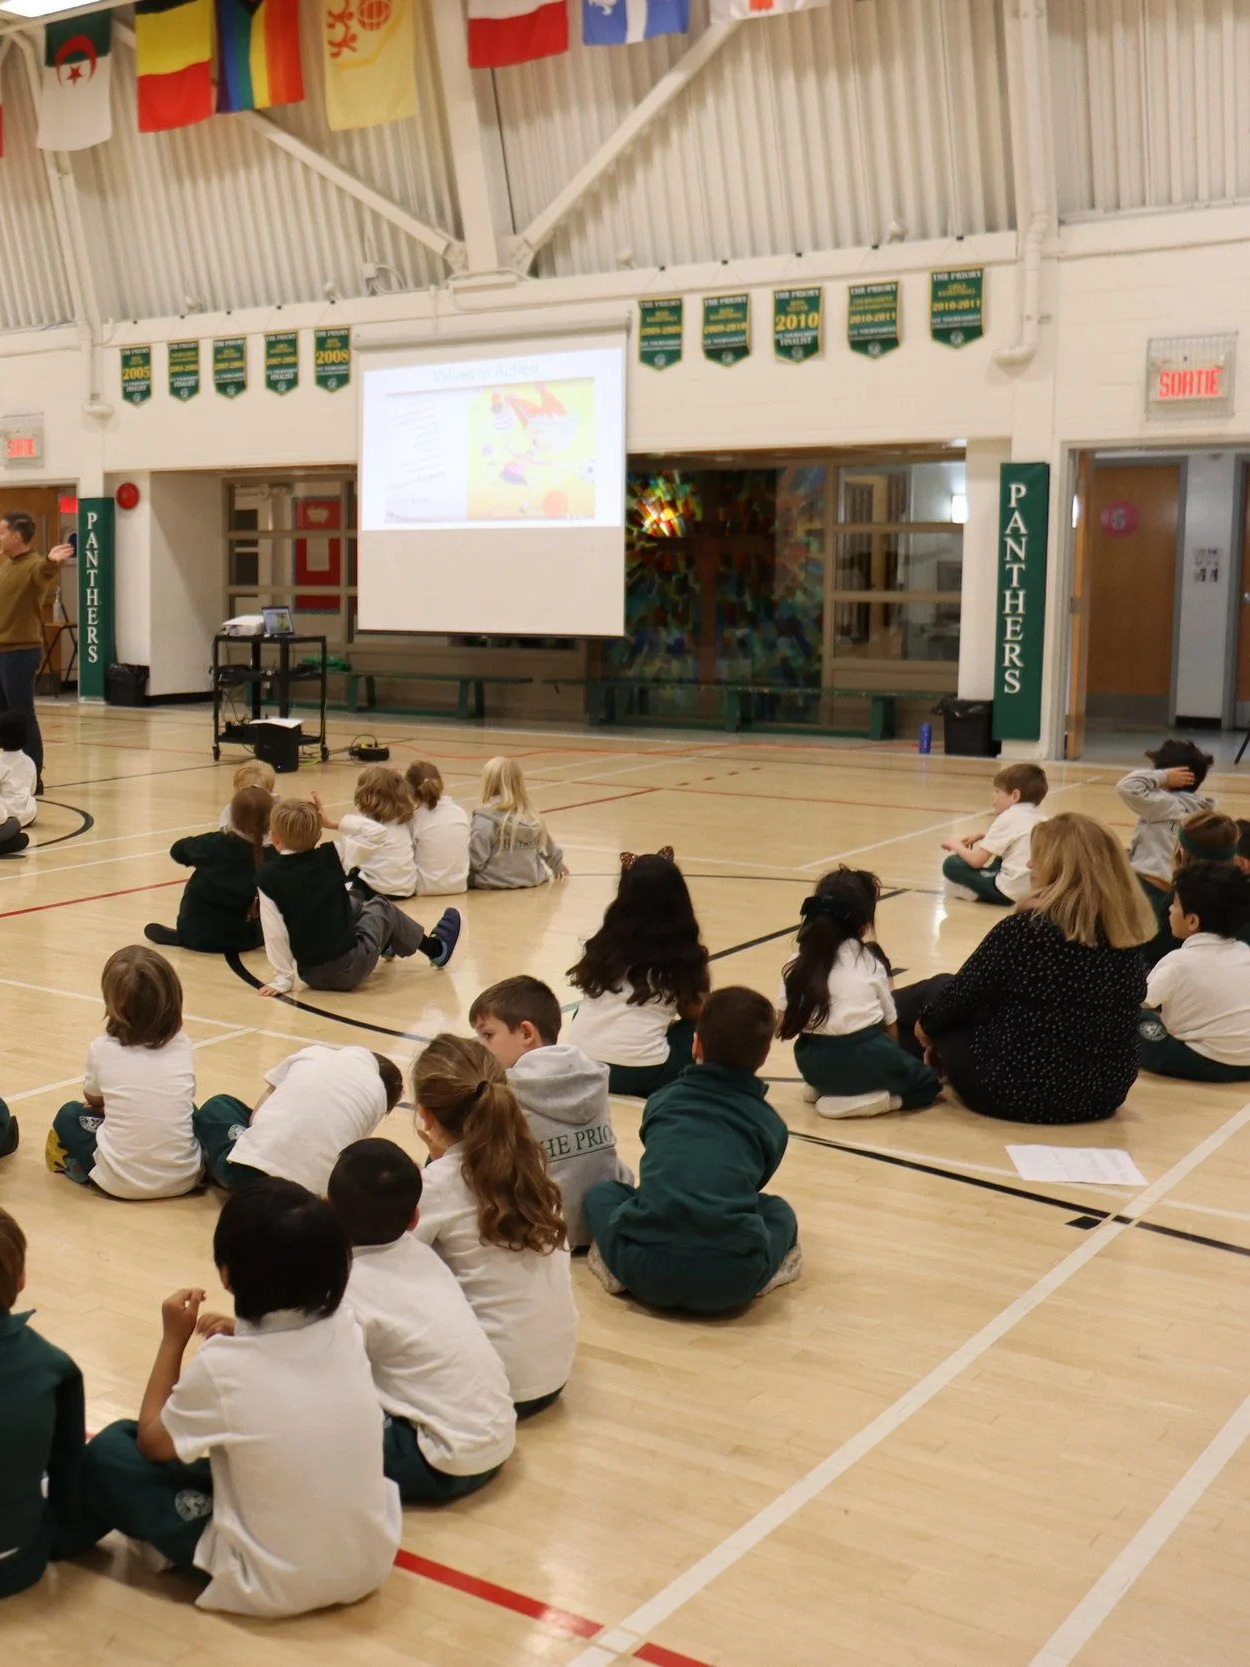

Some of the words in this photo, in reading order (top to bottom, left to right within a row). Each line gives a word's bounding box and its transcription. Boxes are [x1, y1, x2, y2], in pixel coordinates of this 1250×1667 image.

[776, 312, 819, 331] 2010
[316, 349, 350, 364] 2008
[122, 366, 150, 380] 2005
[433, 368, 476, 384] Values
[1159, 368, 1221, 398] SORTIE
[86, 512, 99, 663] PANTHERS
[1002, 483, 1029, 694] PANTHERS
